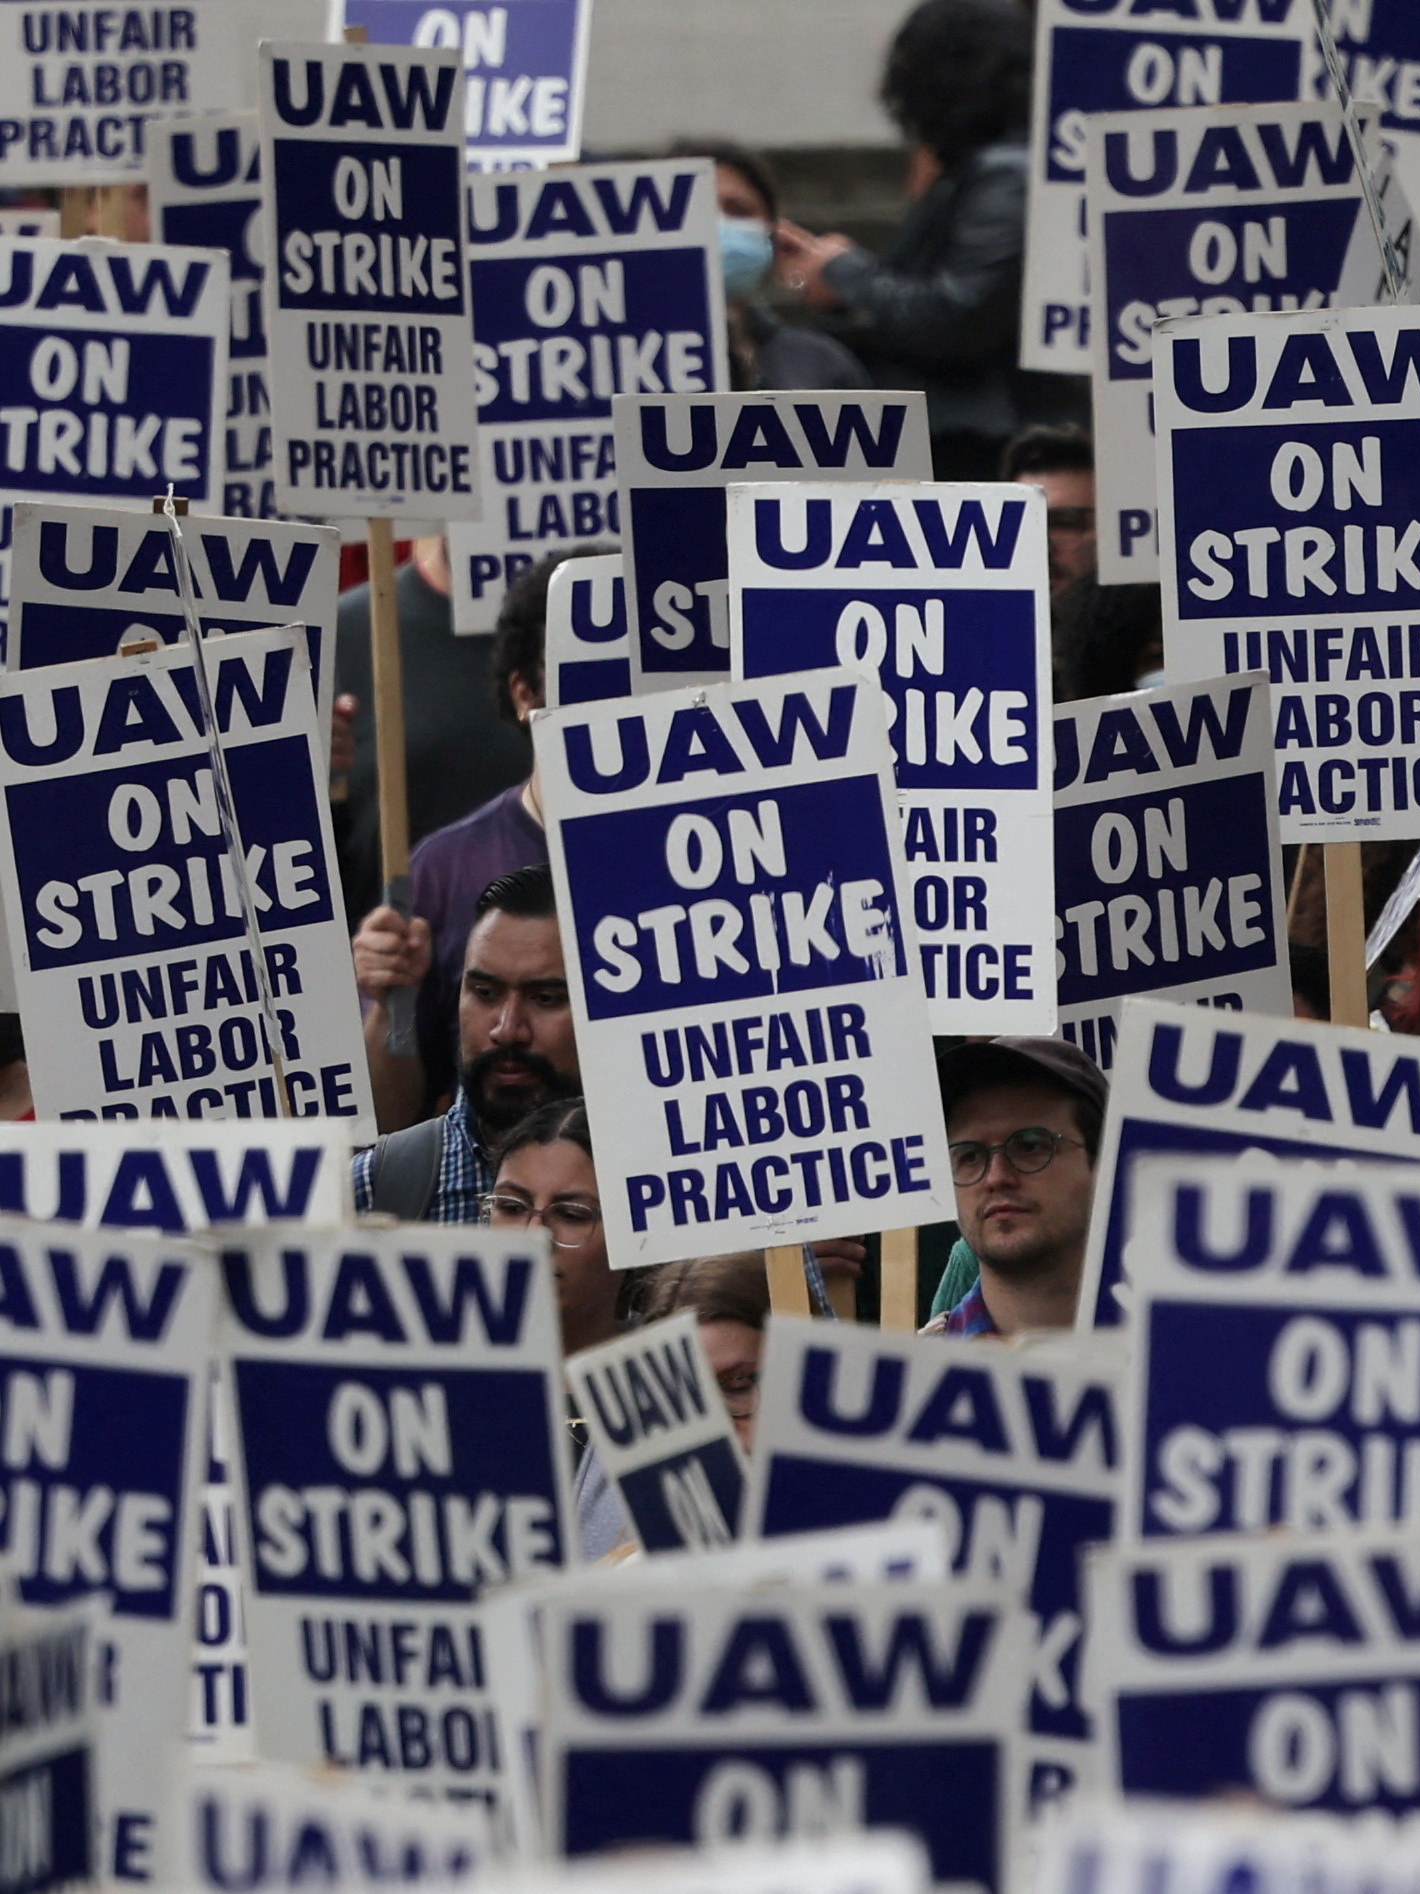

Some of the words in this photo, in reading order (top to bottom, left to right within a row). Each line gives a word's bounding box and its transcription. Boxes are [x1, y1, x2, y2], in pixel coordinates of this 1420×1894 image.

[22, 7, 197, 55] UNFAIR
[413, 7, 507, 68] ON
[32, 61, 188, 107] LABOR
[272, 59, 457, 131] UAW
[466, 76, 569, 137] IKE
[1128, 42, 1223, 105] ON
[1, 118, 145, 160] PRACT
[1105, 119, 1369, 197] UAW
[333, 156, 403, 221] ON
[468, 174, 697, 244] UAW
[283, 231, 459, 300] STRIKE
[1189, 216, 1287, 284] ON
[525, 259, 627, 328] ON
[30, 336, 131, 404] ON
[307, 322, 442, 374] UNFAIR
[0, 405, 202, 481] TRIKE
[316, 382, 438, 433] LABOR
[640, 404, 907, 472] UAW
[288, 440, 472, 494] PRACTICE
[493, 434, 616, 485] UNFA
[1269, 436, 1383, 511] ON
[38, 520, 320, 607] UAW
[755, 499, 1027, 571] UAW
[835, 599, 944, 678] ON
[0, 647, 294, 767] UAW
[562, 684, 858, 795] UAW
[881, 686, 1030, 767] IKE
[107, 768, 224, 852] ON
[665, 799, 788, 889] ON
[900, 807, 998, 862] AIR
[1091, 798, 1188, 884] ON
[35, 840, 321, 949] STRIKE
[1056, 873, 1266, 980] TRIKE
[593, 878, 891, 993] STRIKE
[920, 945, 1033, 999] TICE
[77, 942, 303, 1030] UNFAIR
[99, 1010, 302, 1092] LABOR
[641, 1003, 872, 1088] UNFAIR
[663, 1073, 870, 1157] LABOR
[0, 1147, 323, 1231] UAW
[626, 1134, 931, 1233] PRACTICE
[219, 1249, 535, 1346] UAW
[4, 1367, 76, 1470] N
[327, 1382, 453, 1477] ON
[584, 1336, 709, 1451] UAW
[799, 1341, 1118, 1471] UAW
[257, 1485, 558, 1585] STRIKE
[302, 1614, 486, 1689] UNFAI
[568, 1610, 1000, 1720] UAW
[1250, 1681, 1420, 1802] ON
[695, 1757, 866, 1846] ON
